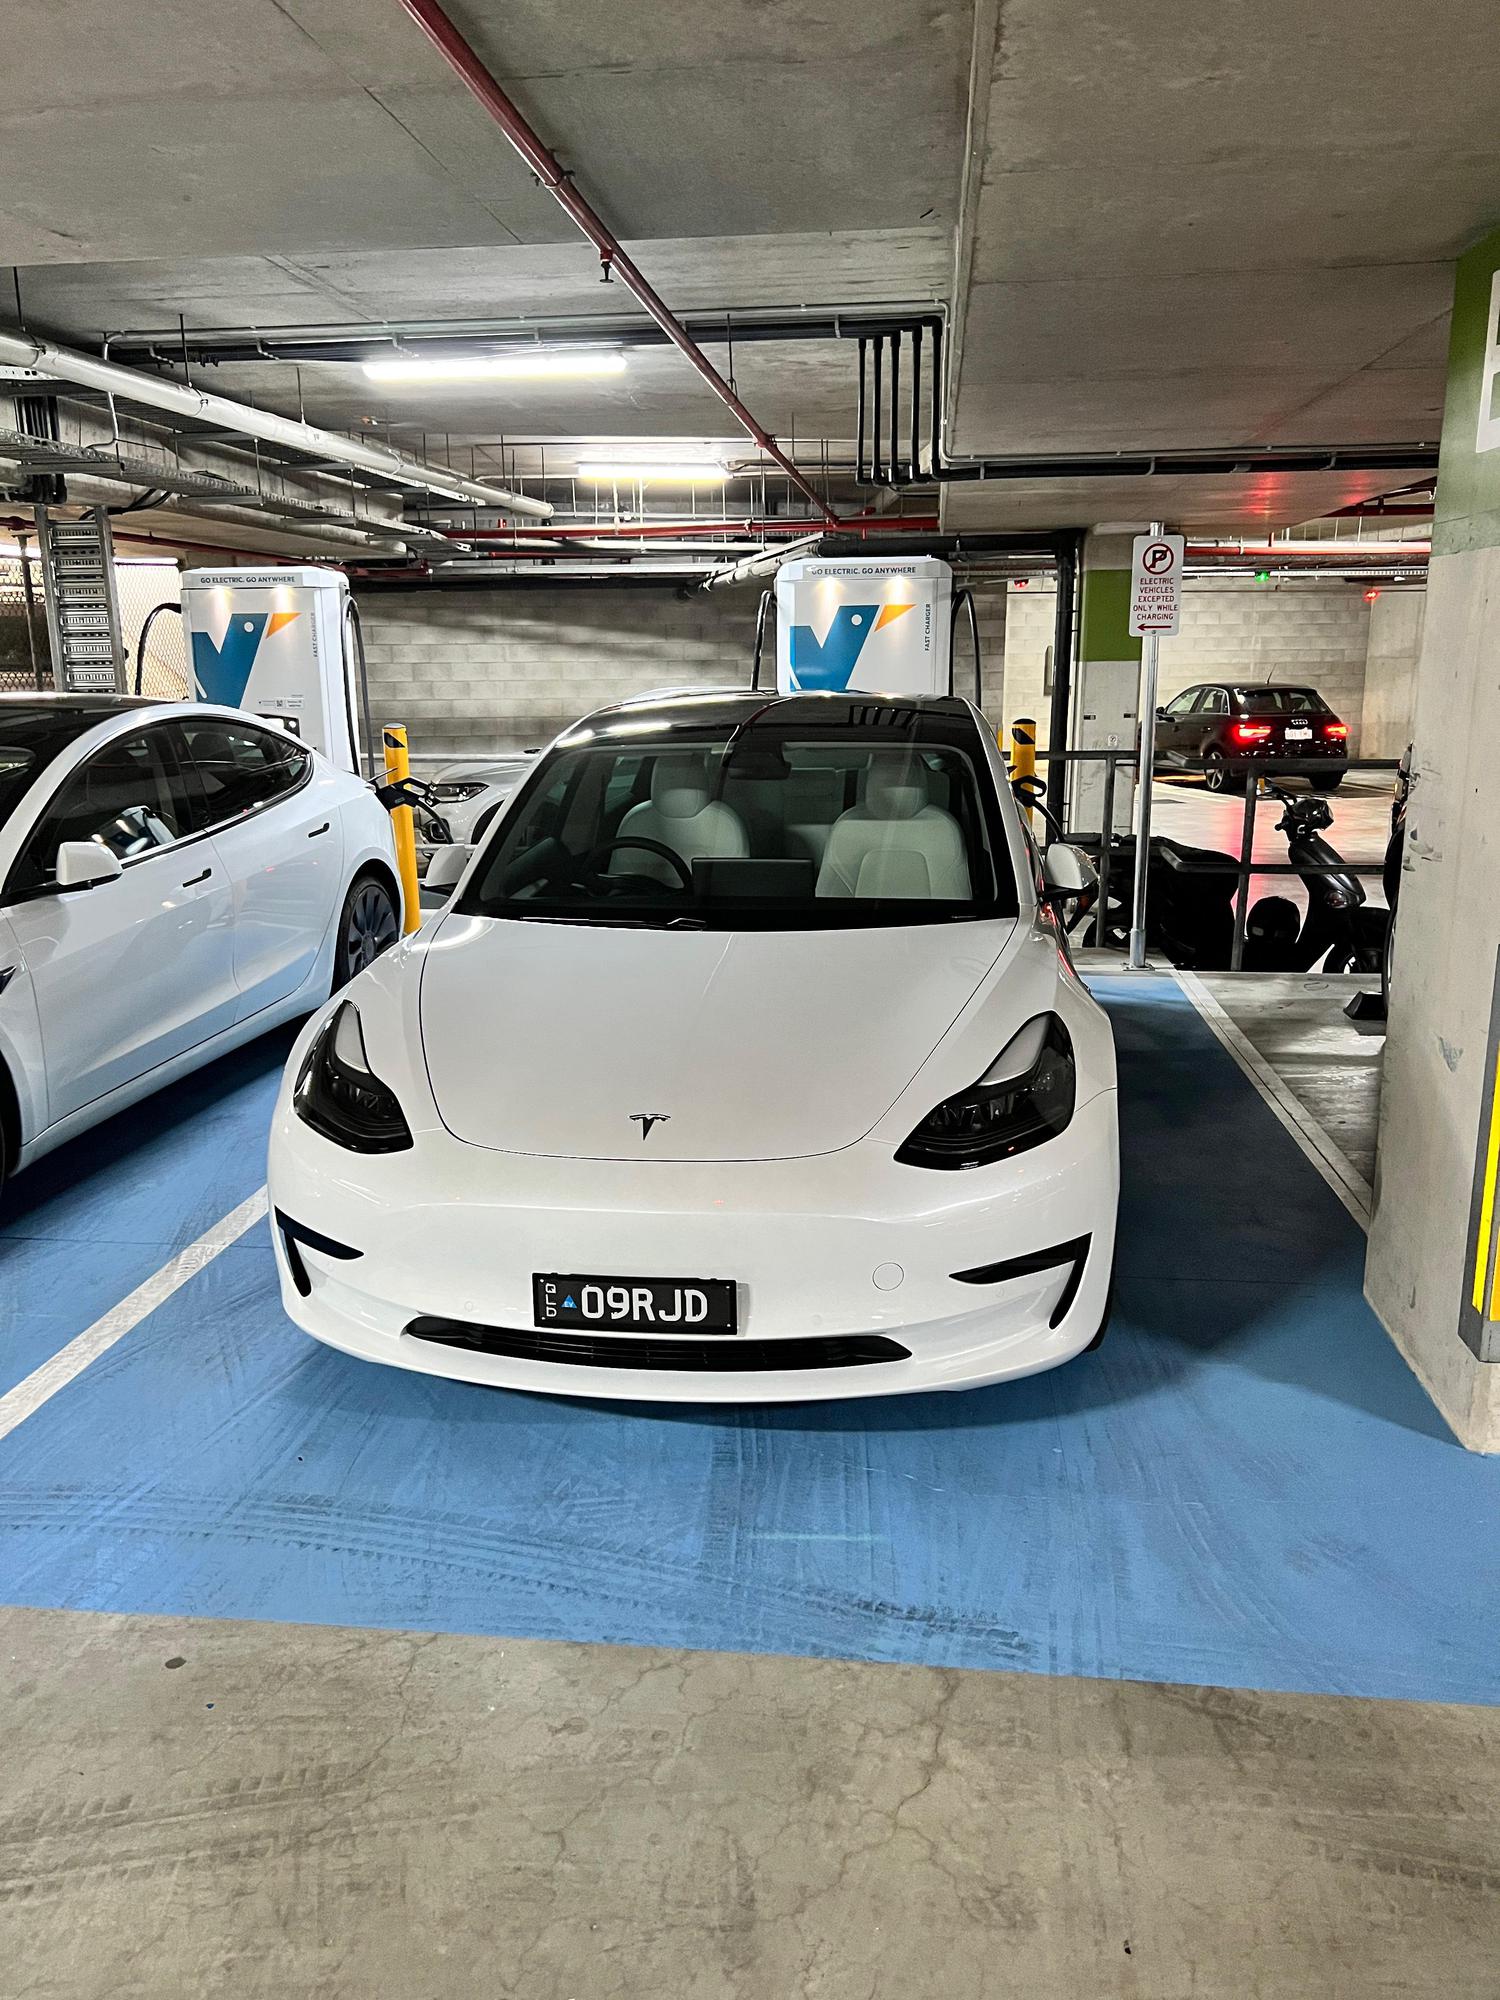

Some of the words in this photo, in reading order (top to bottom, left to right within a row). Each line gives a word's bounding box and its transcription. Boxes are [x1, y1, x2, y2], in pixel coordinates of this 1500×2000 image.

[875, 566, 916, 574] ANYWHERE
[1140, 586, 1174, 594] VEHICLES
[1138, 595, 1175, 603] EXCEPTED
[1133, 604, 1153, 612] ONLY
[545, 1282, 557, 1317] QLD
[581, 1285, 708, 1322] 09RJD
